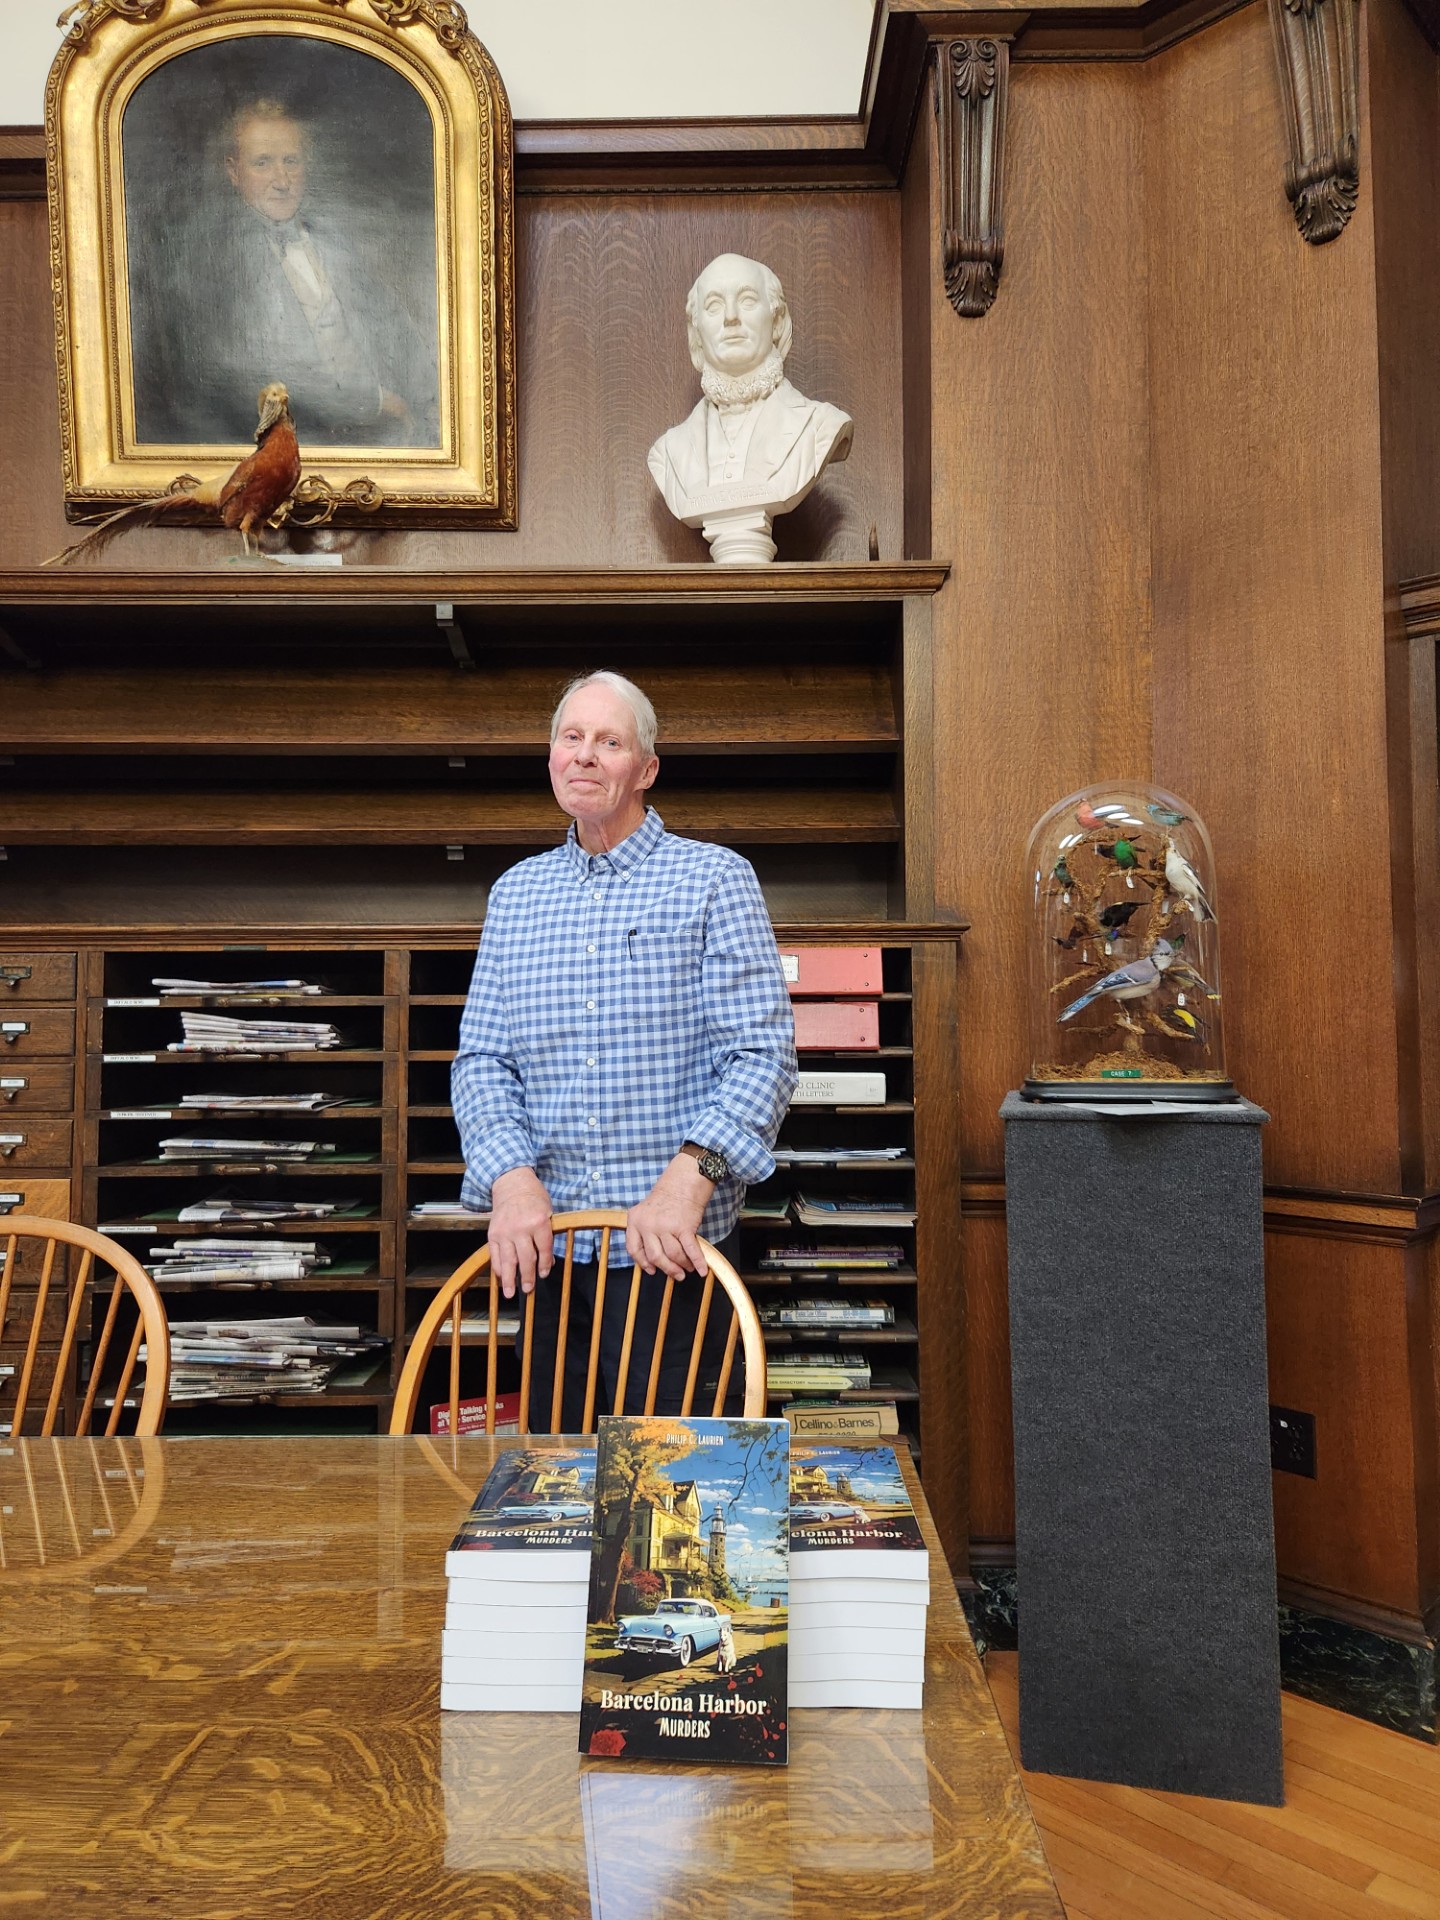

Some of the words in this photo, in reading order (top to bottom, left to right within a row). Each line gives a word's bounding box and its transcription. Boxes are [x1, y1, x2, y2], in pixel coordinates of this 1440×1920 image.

[459, 1404, 483, 1416] Talking
[461, 1413, 486, 1424] Service
[800, 1419, 833, 1430] Cellino
[838, 1417, 874, 1428] Barnes
[666, 1432, 687, 1445] PHILIP
[698, 1434, 724, 1447] LAURIEN
[475, 1528, 559, 1538] Barcelona
[564, 1528, 593, 1537] Har
[790, 1529, 836, 1538] elona
[841, 1529, 904, 1539] Harbor
[525, 1536, 573, 1545] MURDERS
[807, 1536, 855, 1546] MURDERS
[600, 1689, 693, 1712] Barcelona
[698, 1693, 767, 1715] Harbor
[659, 1716, 711, 1739] MURDERS
